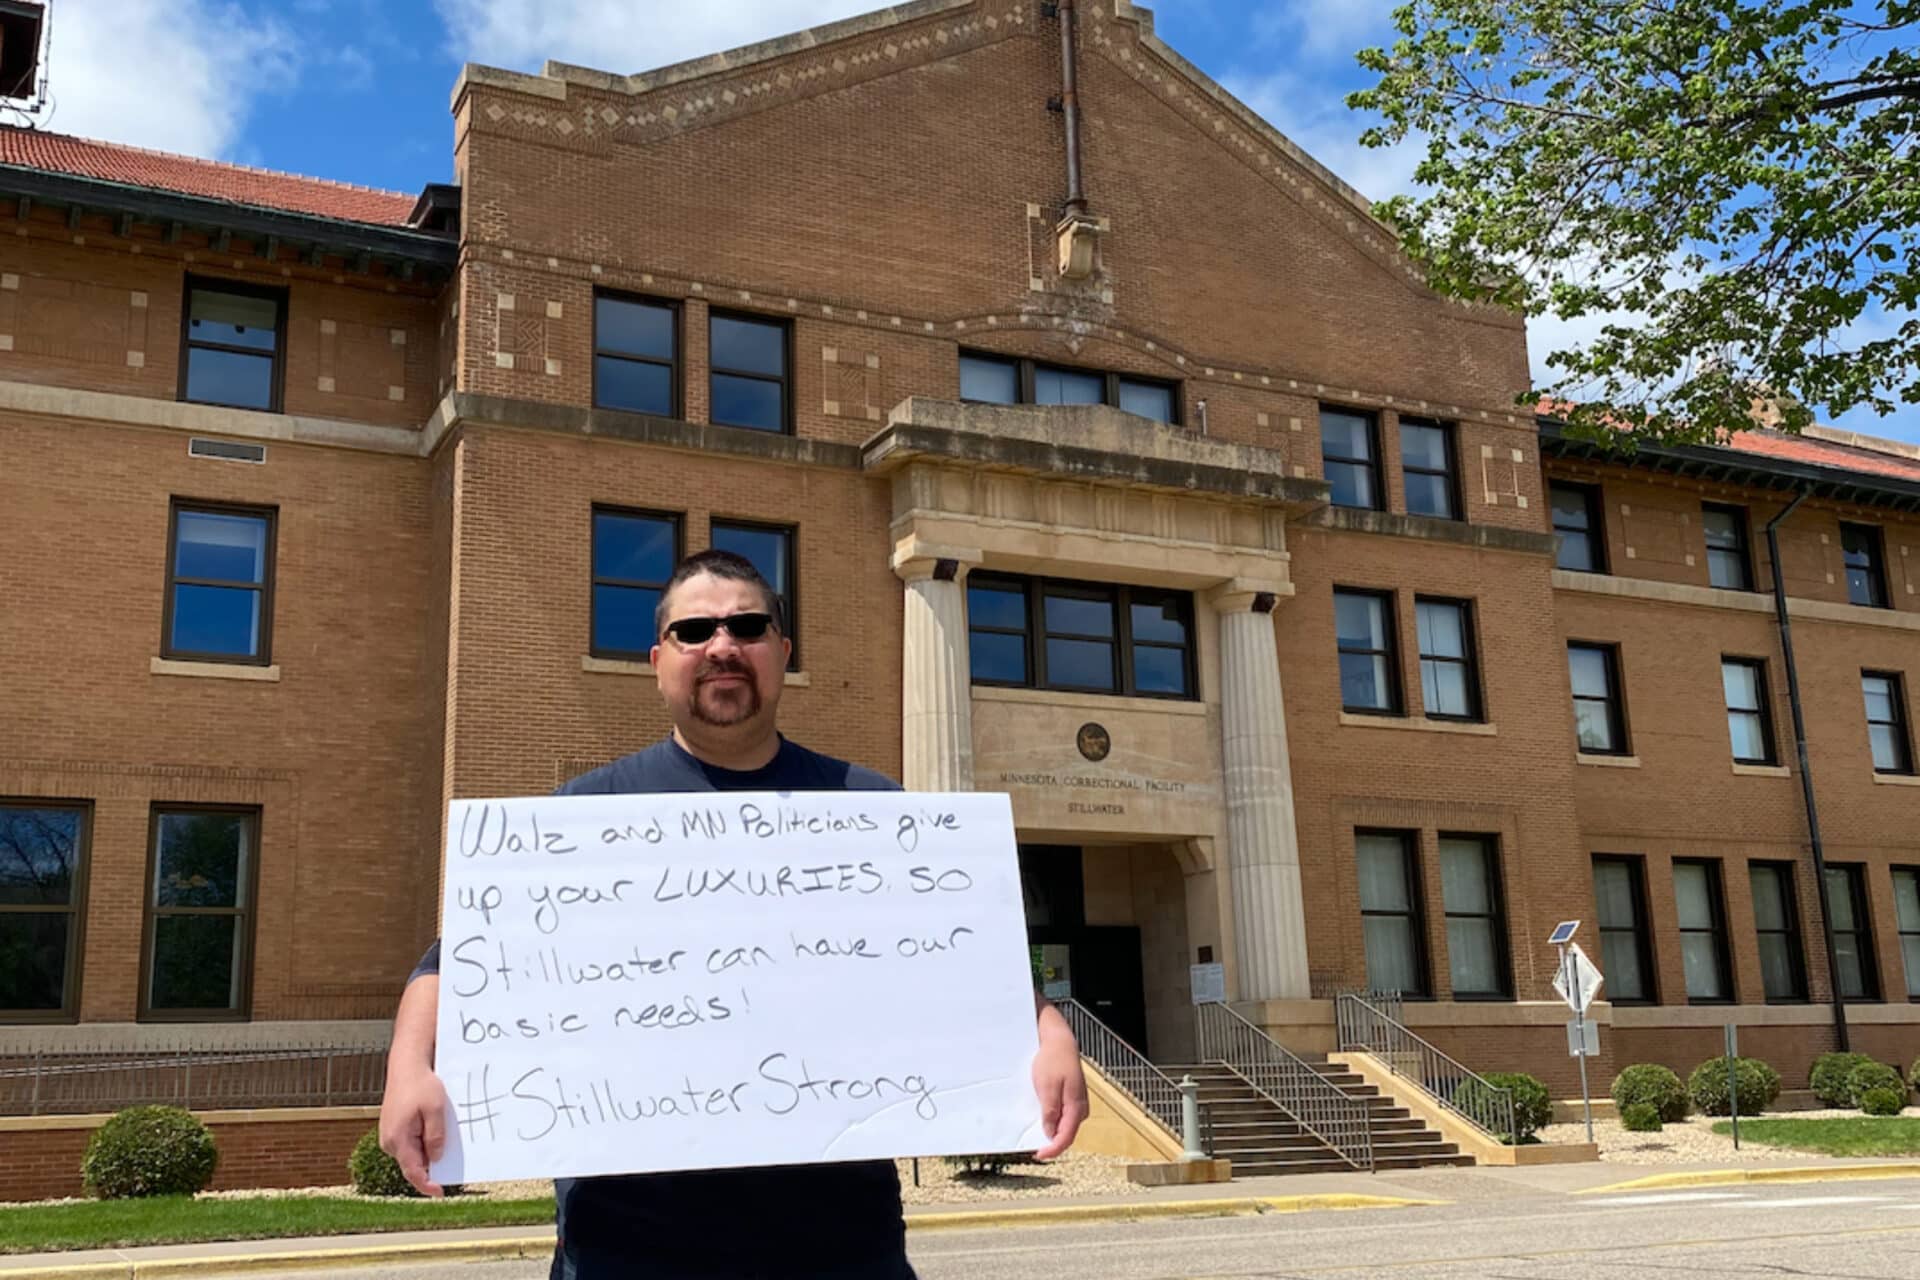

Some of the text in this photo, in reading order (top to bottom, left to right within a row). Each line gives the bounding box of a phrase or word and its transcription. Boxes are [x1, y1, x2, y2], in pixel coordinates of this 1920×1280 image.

[1000, 773, 1186, 793] MINNESOTA CORRECTIONAL FACILITY
[1068, 802, 1125, 815] STILLWATER
[459, 803, 961, 857] Walz and MN Politicians give
[458, 884, 503, 925] up
[527, 878, 633, 933] your
[452, 927, 974, 997] Stillwater can have our
[461, 988, 751, 1044] basic needs!
